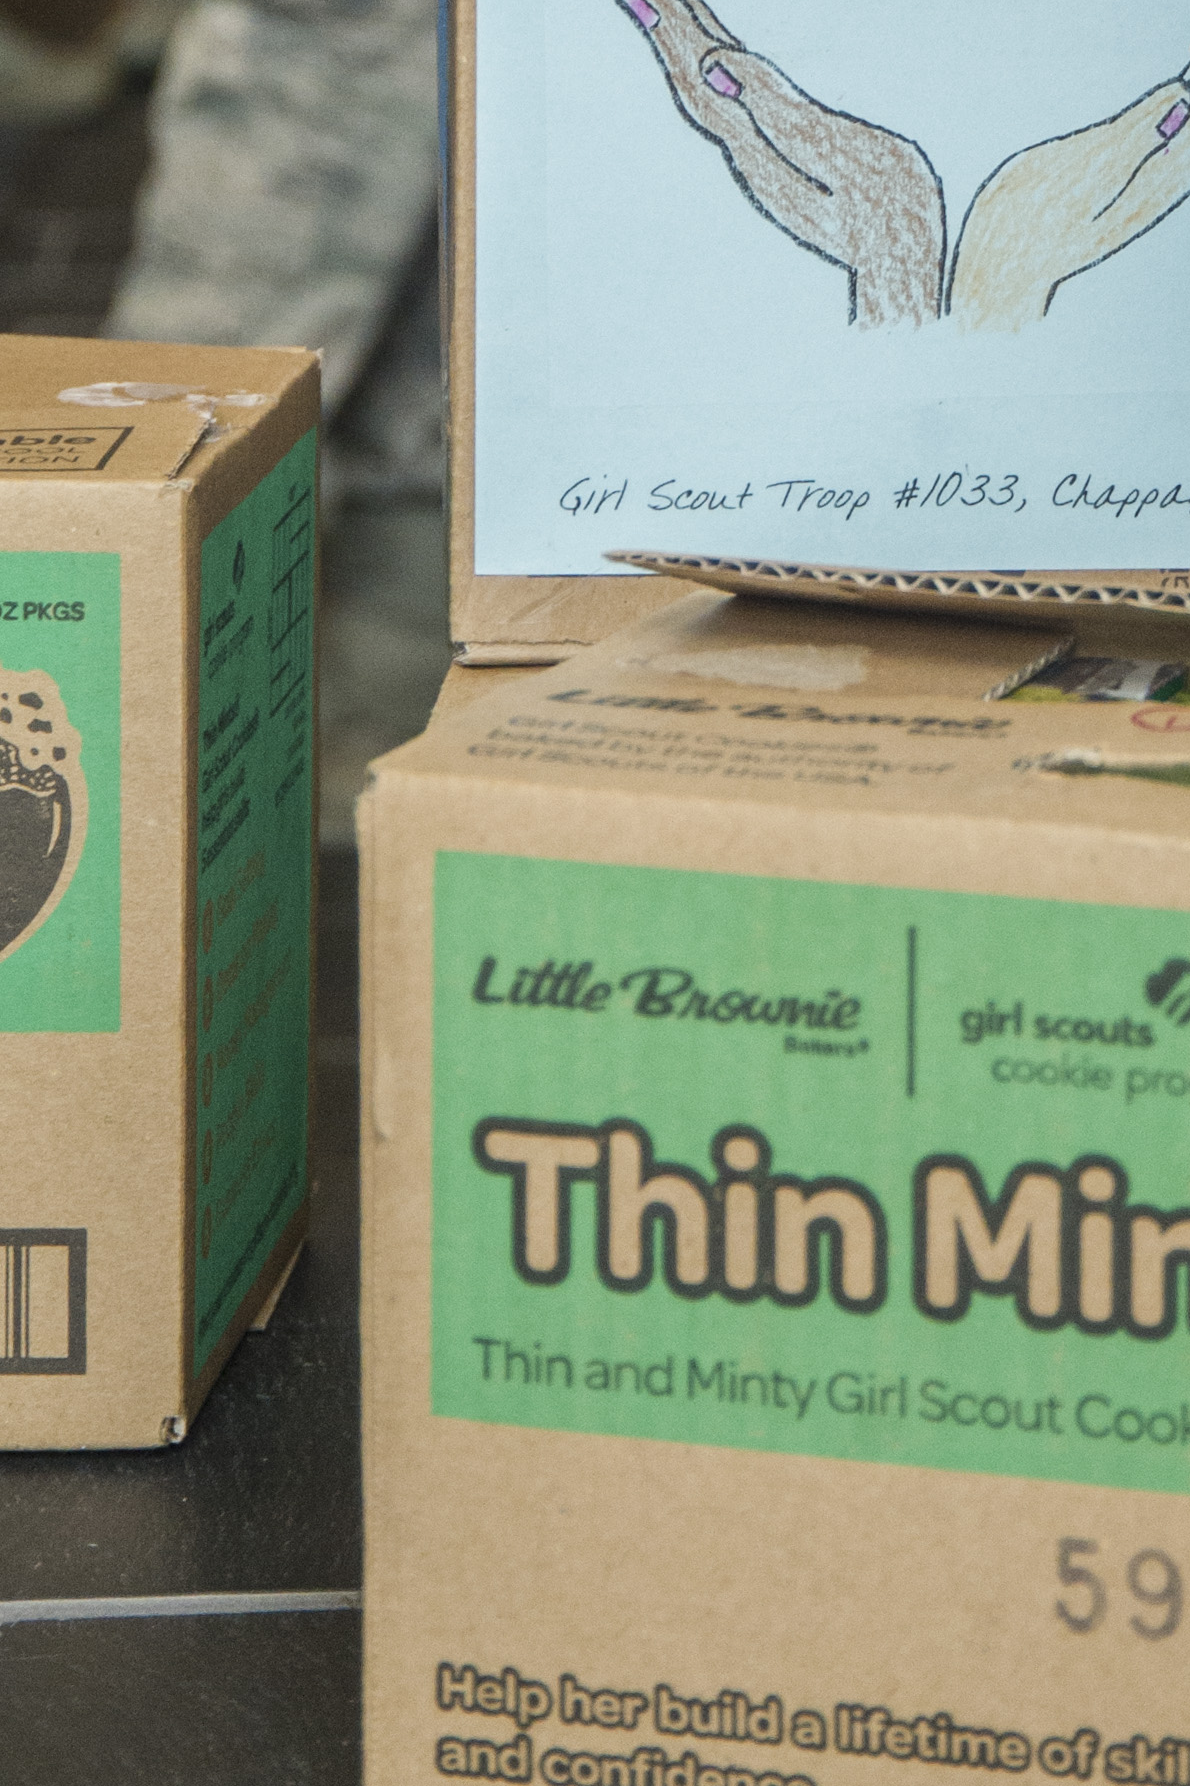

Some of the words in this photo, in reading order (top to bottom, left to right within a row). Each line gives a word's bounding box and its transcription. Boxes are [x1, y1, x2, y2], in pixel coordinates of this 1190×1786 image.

[0, 435, 97, 446] ble
[559, 474, 629, 516] Girl
[647, 478, 754, 511] Scout
[766, 478, 871, 521] Troop
[0, 600, 18, 621] Z
[23, 600, 85, 621] PKGS
[471, 954, 612, 1013] Little
[617, 965, 863, 1031] Brownie
[960, 998, 1025, 1046] girl
[1032, 1014, 1157, 1049] scouts
[990, 1051, 1115, 1092] cookie
[471, 1117, 888, 1315] Thin
[472, 1334, 573, 1389] Thin
[585, 1351, 675, 1398] and
[687, 1356, 817, 1417] Minty
[826, 1371, 907, 1418] Girl
[918, 1378, 1064, 1434] Scout
[436, 1661, 553, 1729] Help
[559, 1675, 649, 1729] her
[653, 1684, 784, 1746] build
[791, 1708, 826, 1749] a
[833, 1701, 1032, 1772] lifetime
[1037, 1727, 1101, 1780] of
[436, 1724, 533, 1782] and
